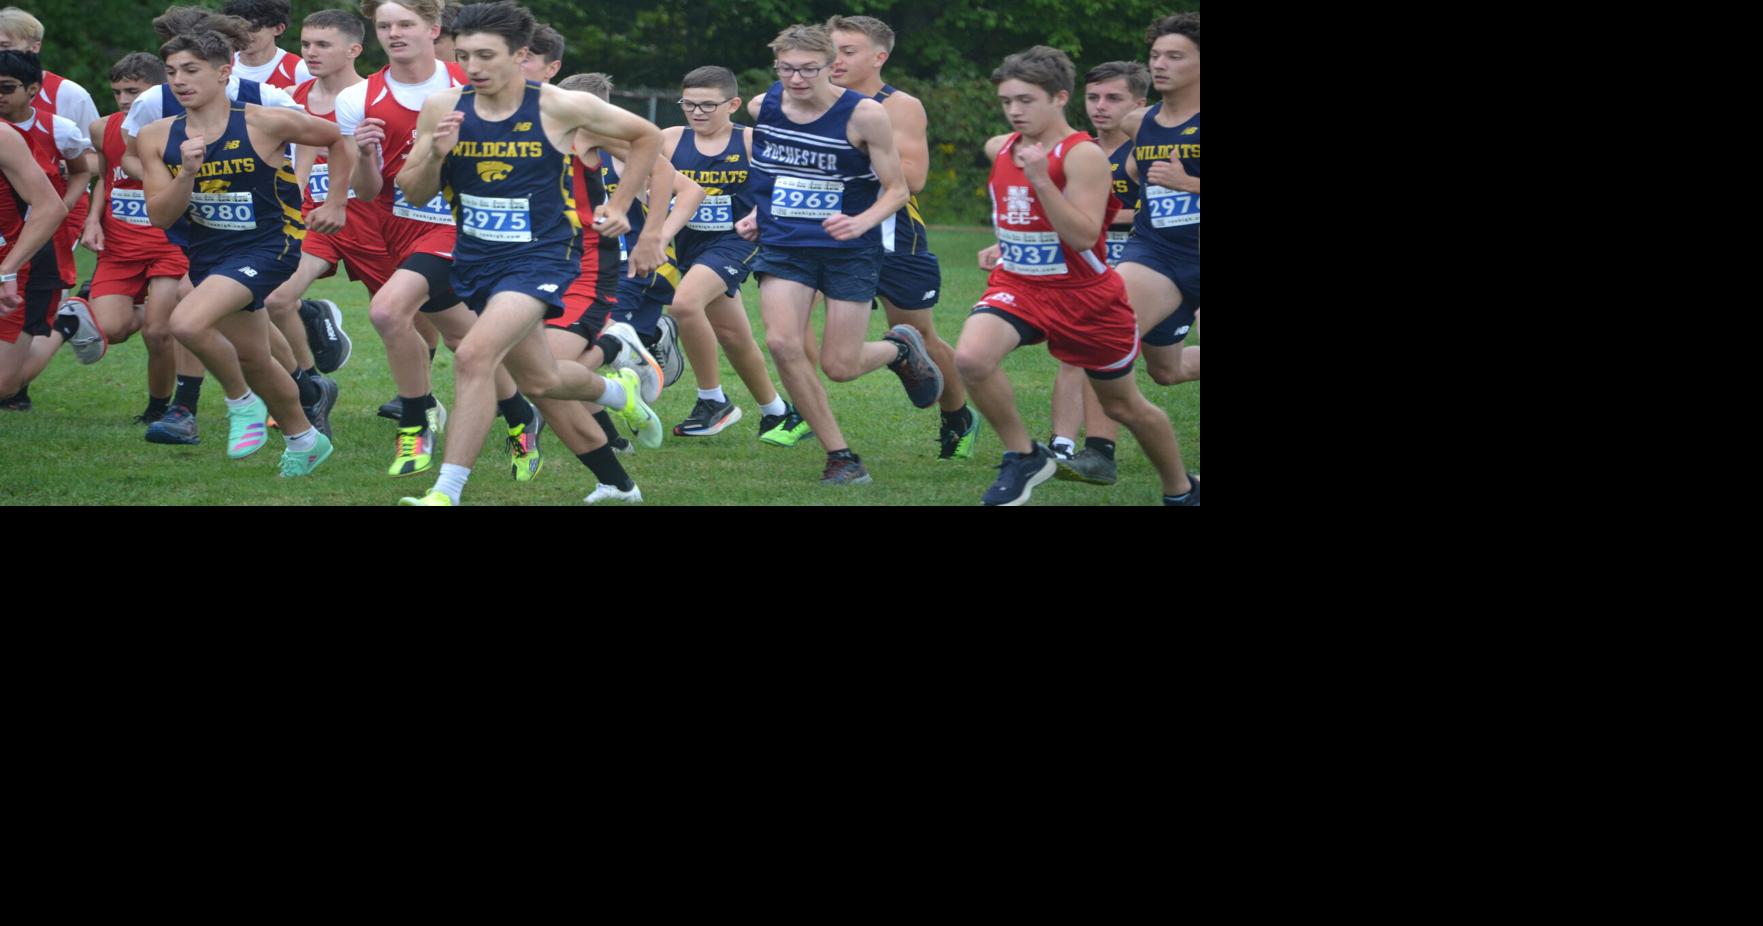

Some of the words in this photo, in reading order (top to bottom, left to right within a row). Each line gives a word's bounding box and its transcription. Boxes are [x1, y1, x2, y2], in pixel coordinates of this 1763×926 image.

[452, 141, 542, 157] WILDCATS
[762, 140, 837, 170] ROCHESTER
[167, 157, 255, 178] WDCATS
[394, 190, 451, 212] 24
[772, 189, 840, 209] 2969
[1149, 195, 1200, 217] 297
[189, 202, 251, 221] 2980
[463, 207, 527, 230] 2975
[690, 207, 729, 222] 85
[1000, 242, 1058, 264] 2937
